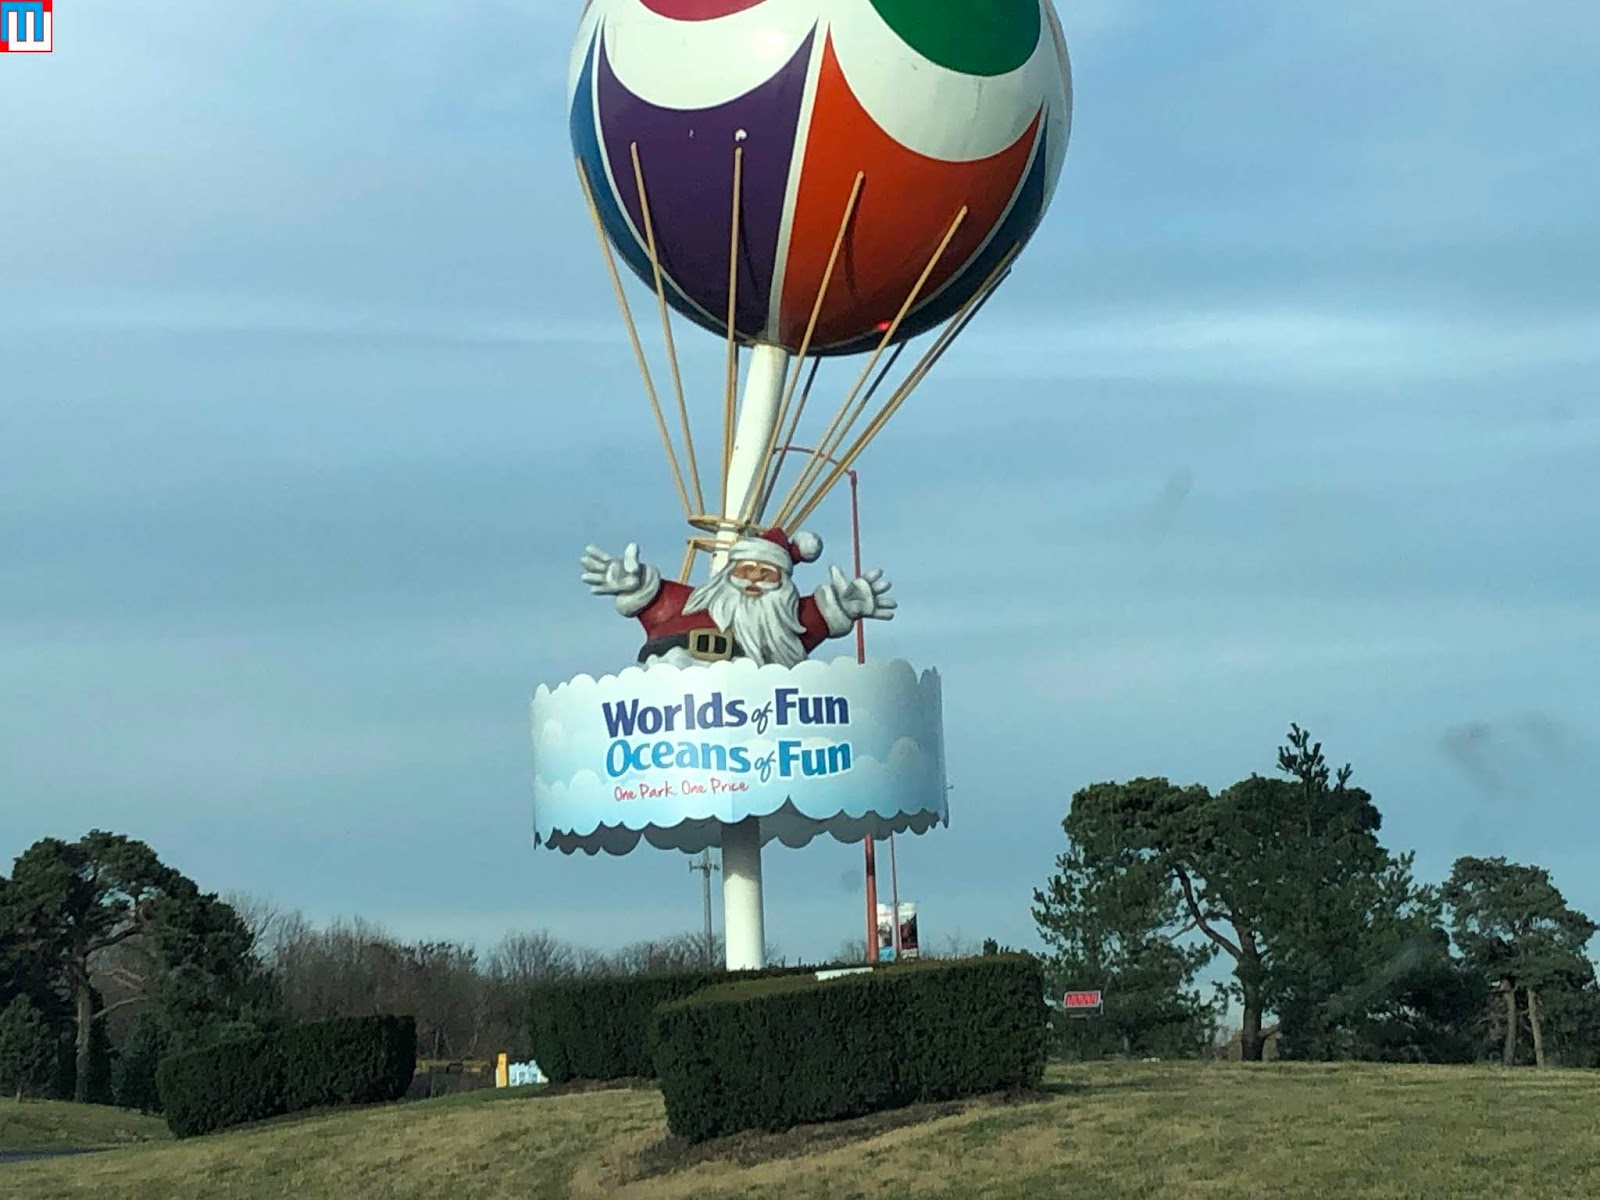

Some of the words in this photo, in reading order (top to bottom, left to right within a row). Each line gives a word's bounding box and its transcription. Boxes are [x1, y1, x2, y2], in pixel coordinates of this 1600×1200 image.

[602, 692, 748, 738] Worlds
[751, 701, 773, 734] of
[775, 688, 849, 725] Fun
[606, 739, 751, 777] Oceans
[755, 751, 776, 782] of
[778, 741, 851, 776] Fun
[614, 786, 637, 801] One
[682, 780, 706, 795] One
[711, 777, 749, 794] Price
